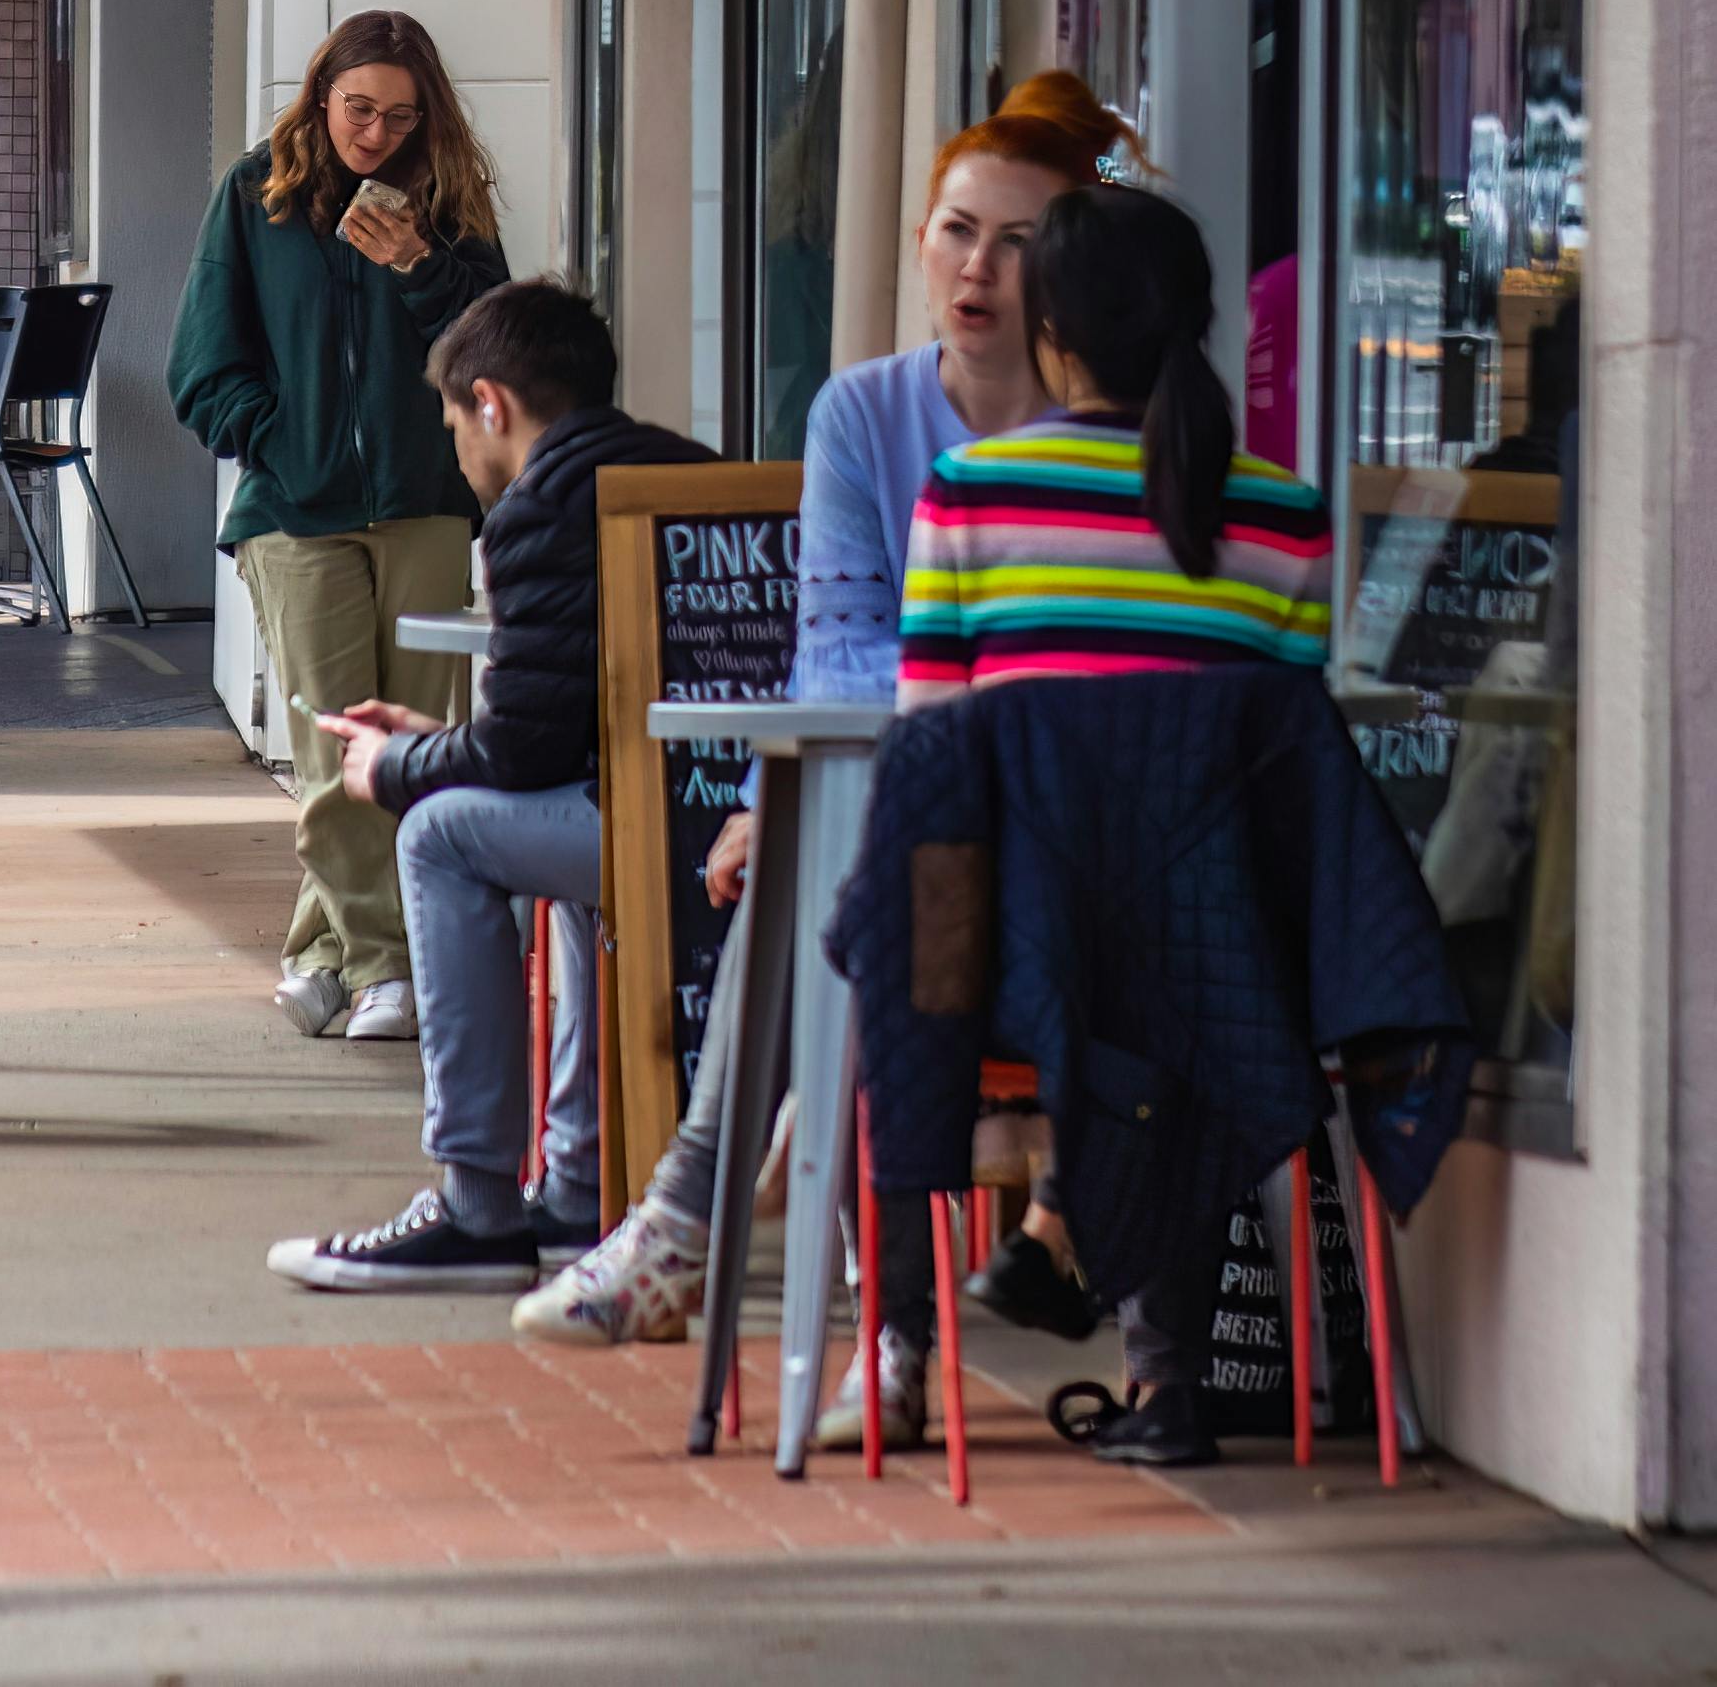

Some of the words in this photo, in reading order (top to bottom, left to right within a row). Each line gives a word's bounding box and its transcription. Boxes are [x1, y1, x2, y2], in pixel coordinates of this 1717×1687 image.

[663, 520, 775, 579] PINK
[665, 581, 759, 615] FOUR
[666, 618, 725, 648] always
[731, 617, 785, 642] made
[712, 647, 773, 682] always
